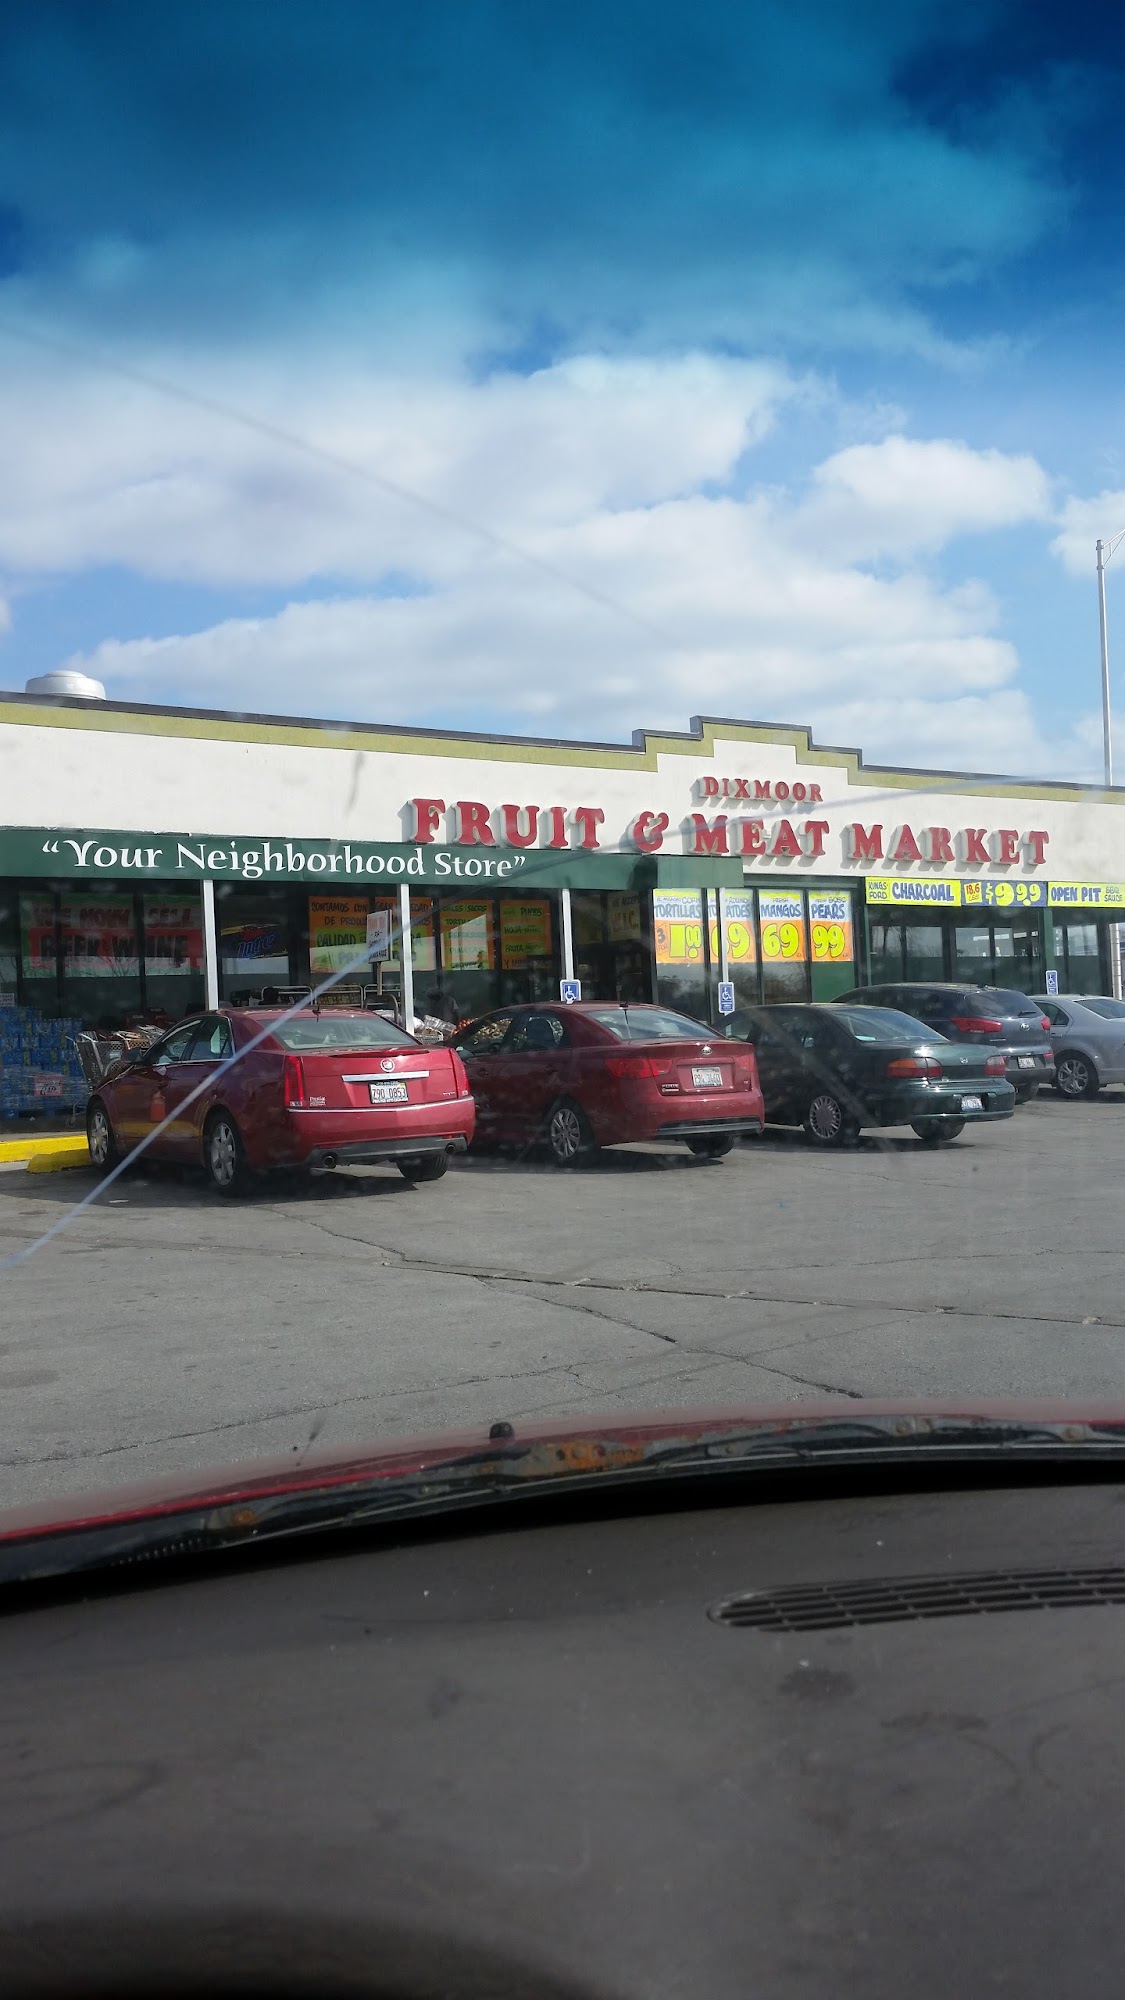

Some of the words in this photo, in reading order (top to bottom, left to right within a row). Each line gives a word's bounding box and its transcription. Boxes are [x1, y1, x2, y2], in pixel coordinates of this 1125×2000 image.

[701, 776, 823, 802] DIXMOOR
[410, 798, 605, 848] FRUIT
[632, 810, 670, 853] &
[689, 813, 830, 857] MEAT
[849, 823, 1050, 865] MARKET
[175, 841, 426, 879] Neighborhood
[869, 891, 887, 899] FORD
[892, 882, 955, 902] CHARCOAL
[1051, 886, 1078, 902] OPEN
[1081, 886, 1102, 902] PIT
[1104, 894, 1123, 902] SAUCE
[682, 896, 700, 904] CORN
[654, 903, 702, 918] TORTILLAS
[760, 903, 802, 918] MANGOS
[811, 903, 846, 919] PEARS
[325, 916, 336, 925] DE
[317, 933, 356, 947] CALIDAD
[656, 928, 666, 943] 3
[762, 923, 799, 958] 69
[812, 924, 845, 958] 99
